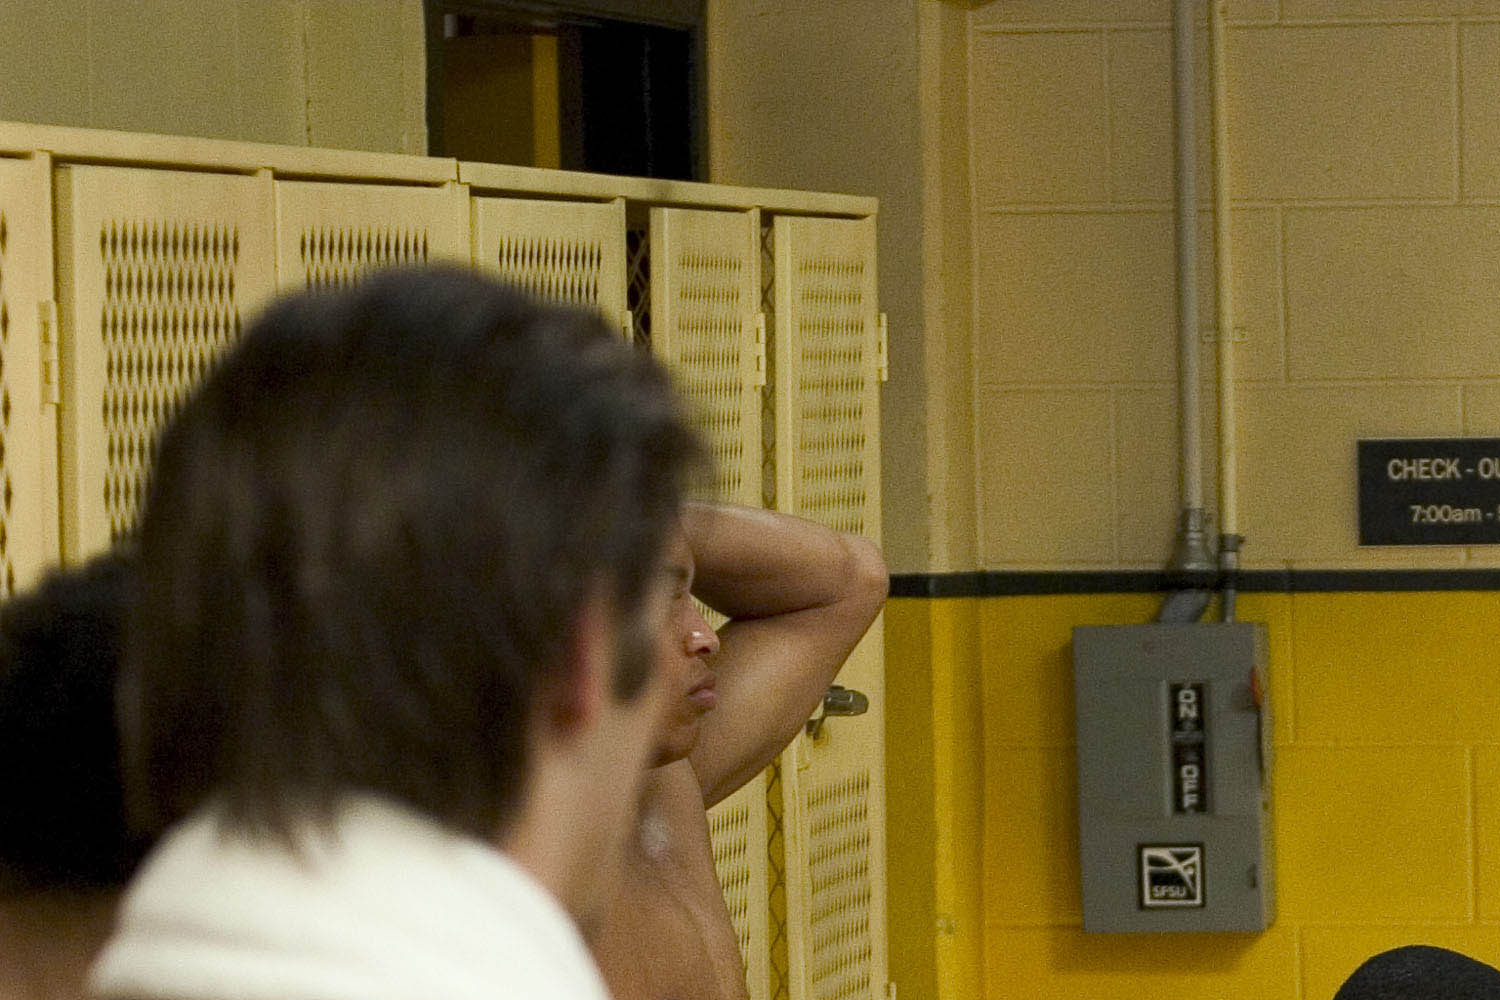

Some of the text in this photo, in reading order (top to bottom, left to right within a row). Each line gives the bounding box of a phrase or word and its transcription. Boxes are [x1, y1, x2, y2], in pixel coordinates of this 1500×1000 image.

[1387, 458, 1462, 481] CHECK
[1410, 504, 1482, 523] 7:00am
[1178, 688, 1198, 719] ON
[1180, 764, 1199, 809] OFF
[1151, 885, 1187, 898] SFSU
